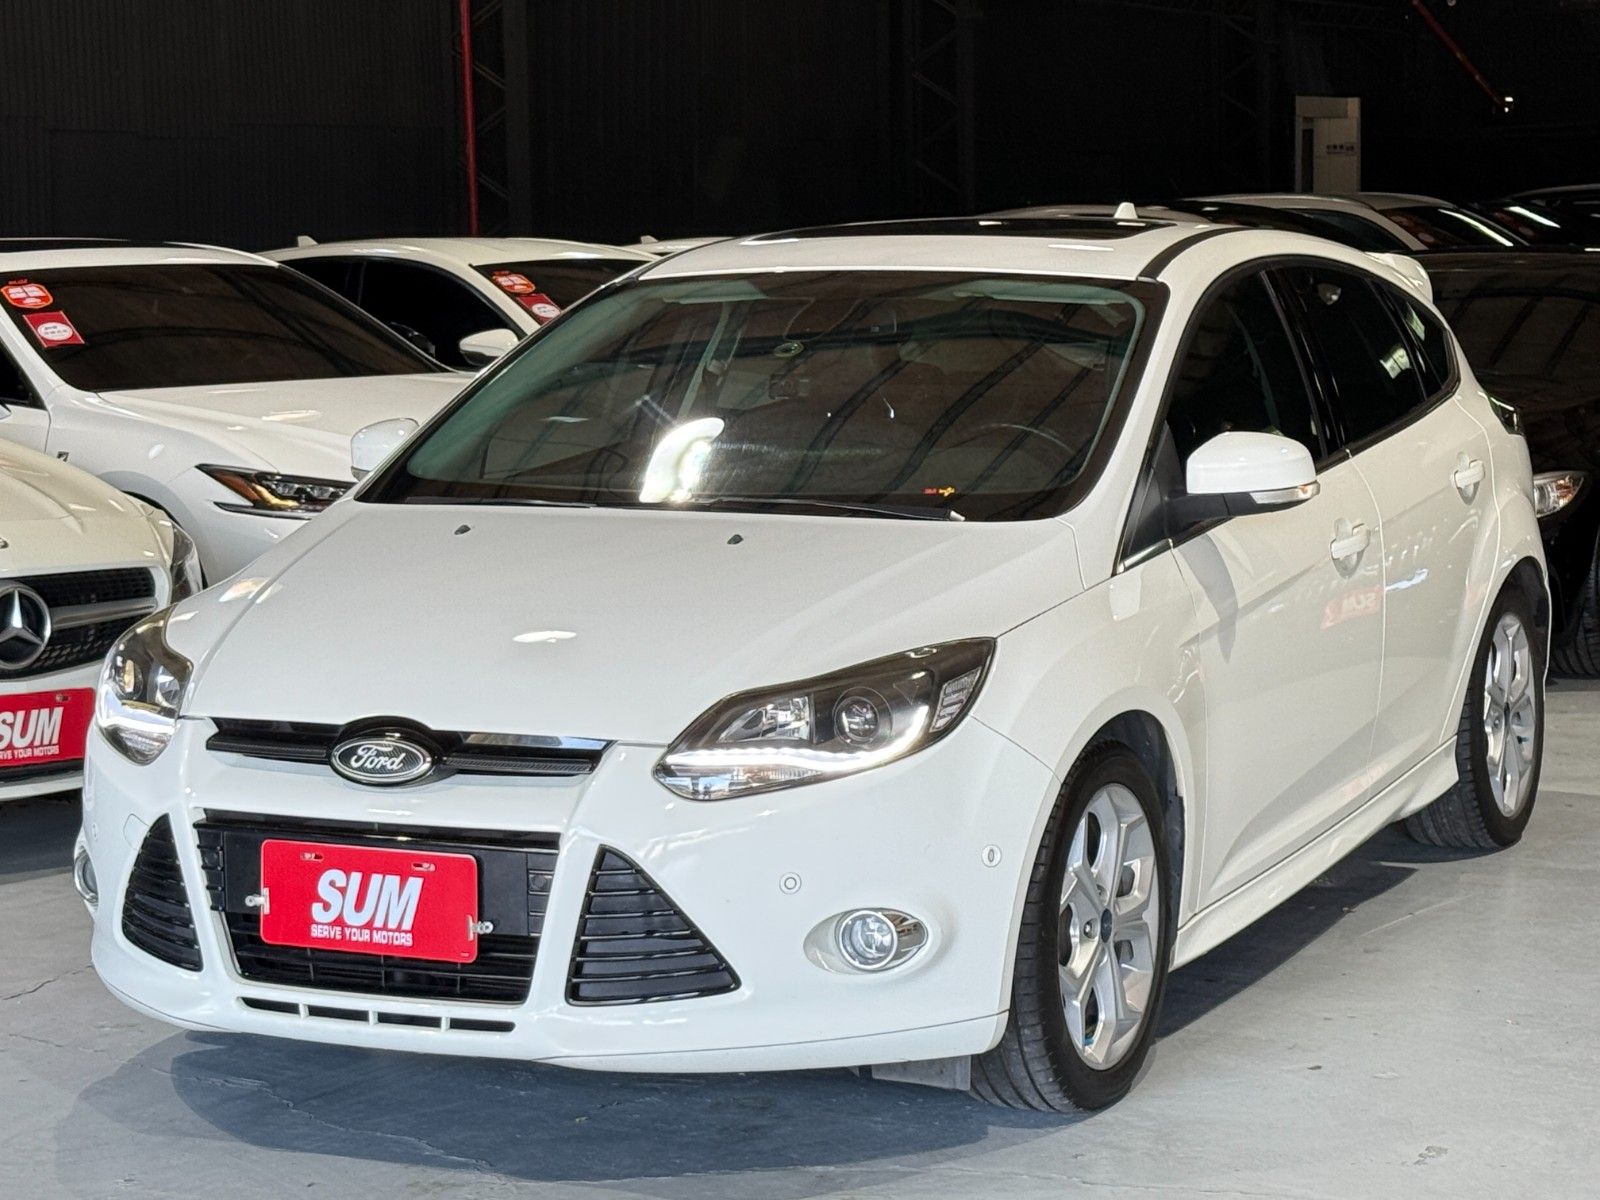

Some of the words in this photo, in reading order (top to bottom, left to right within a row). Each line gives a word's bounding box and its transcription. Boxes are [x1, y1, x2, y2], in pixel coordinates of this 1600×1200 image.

[0, 707, 64, 750] SUM
[13, 748, 33, 759] YOUR
[33, 745, 60, 757] MOTORS
[350, 744, 406, 771] Ford
[311, 868, 424, 931] SUM
[311, 924, 342, 940] SERVE
[344, 927, 371, 943] YOUR
[372, 930, 413, 947] MOTORS
